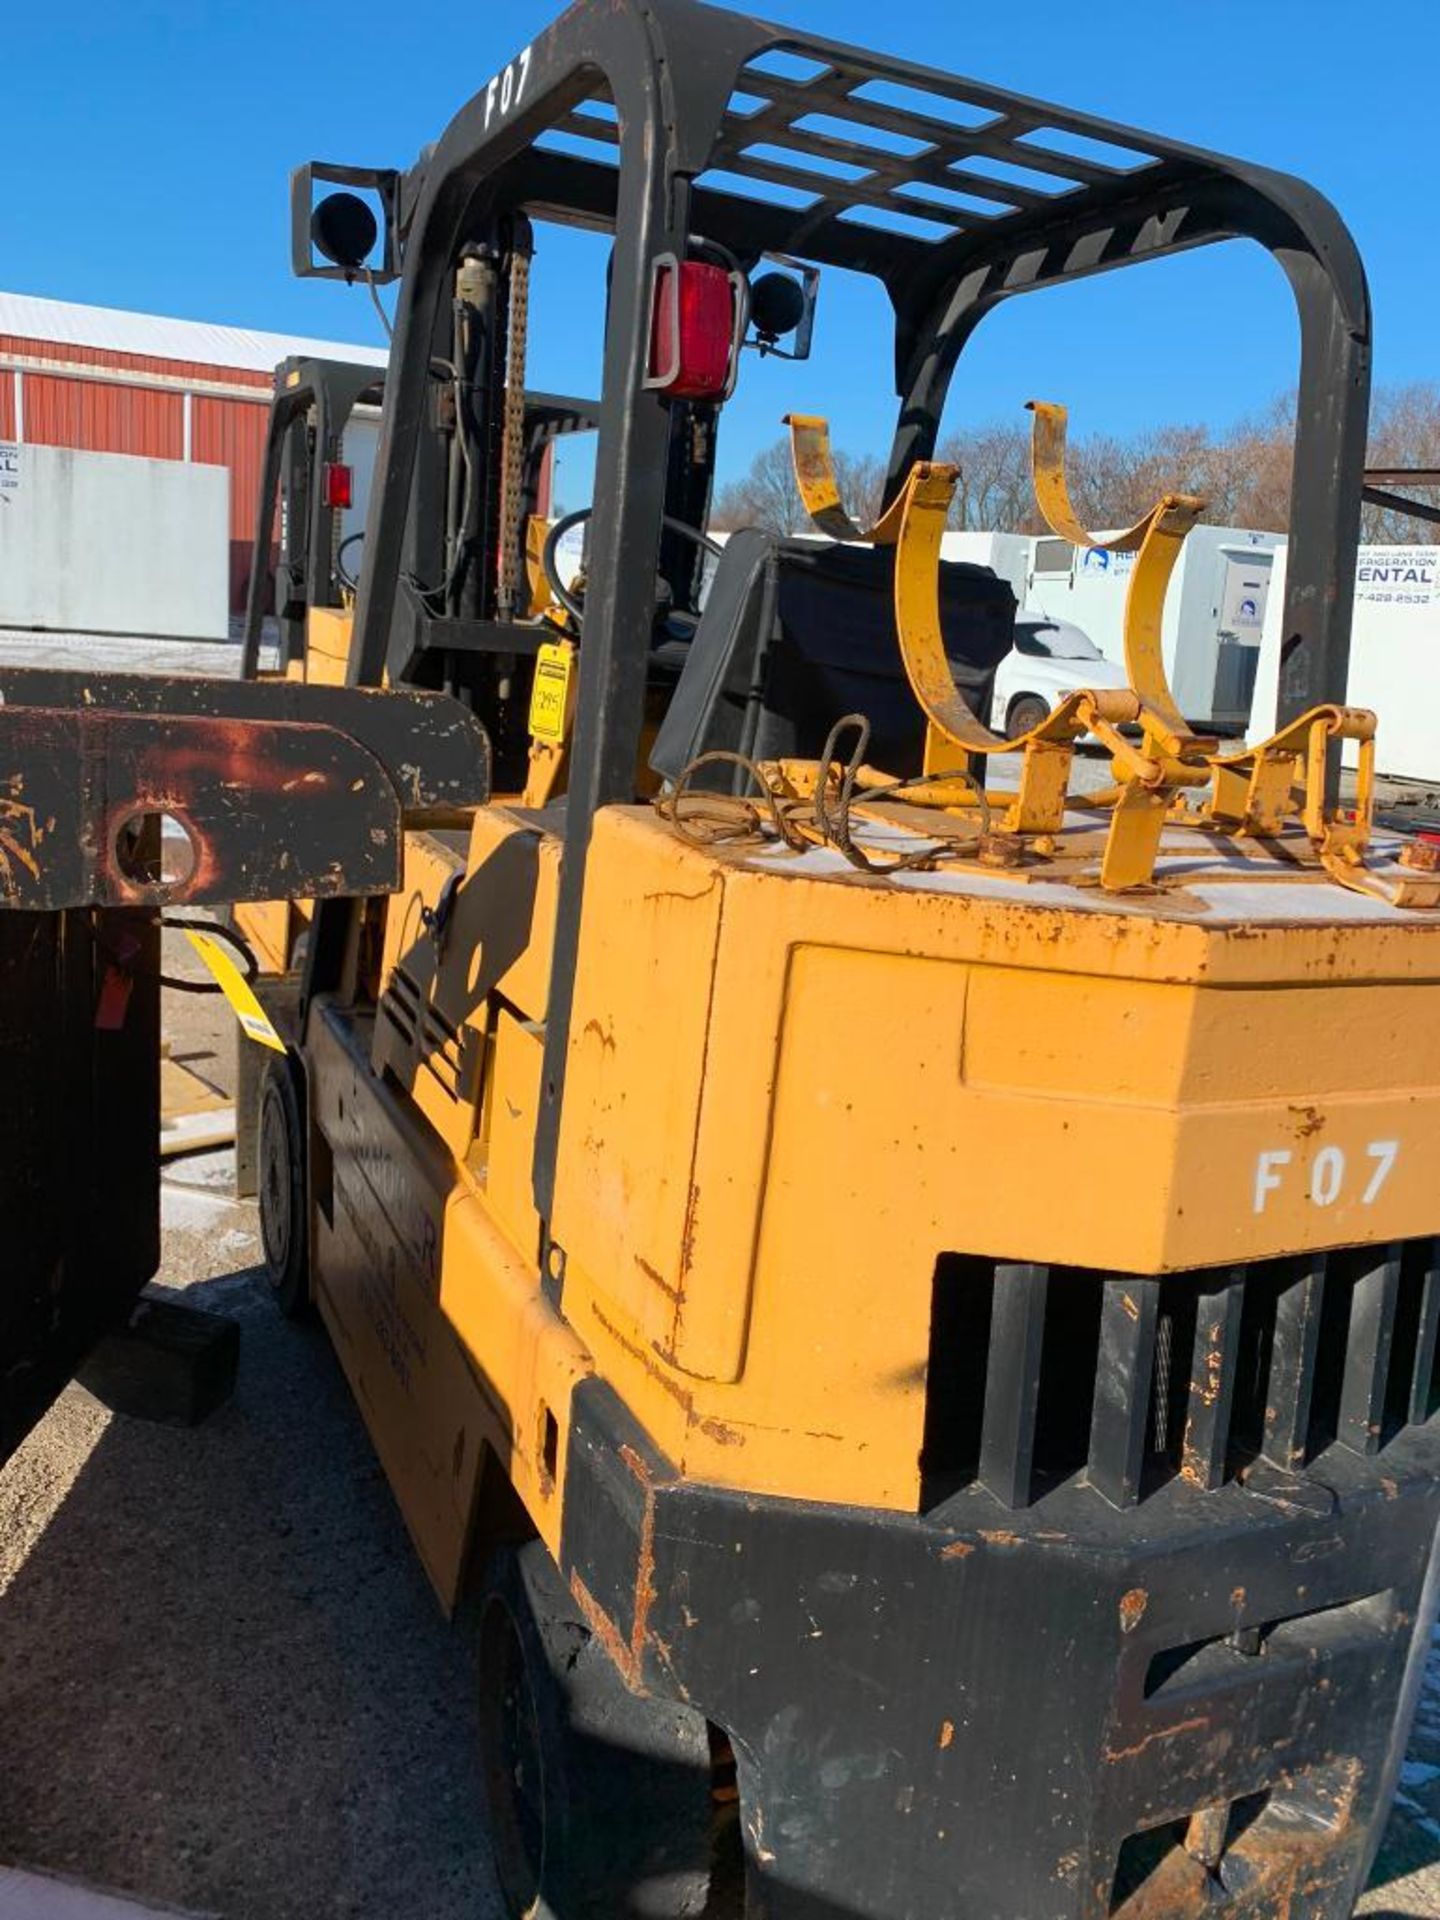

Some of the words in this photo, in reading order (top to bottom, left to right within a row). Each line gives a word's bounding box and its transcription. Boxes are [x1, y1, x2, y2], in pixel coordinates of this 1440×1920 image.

[484, 45, 531, 131] F07
[1358, 567, 1432, 583] ENTAL
[1253, 1141, 1398, 1213] F07
